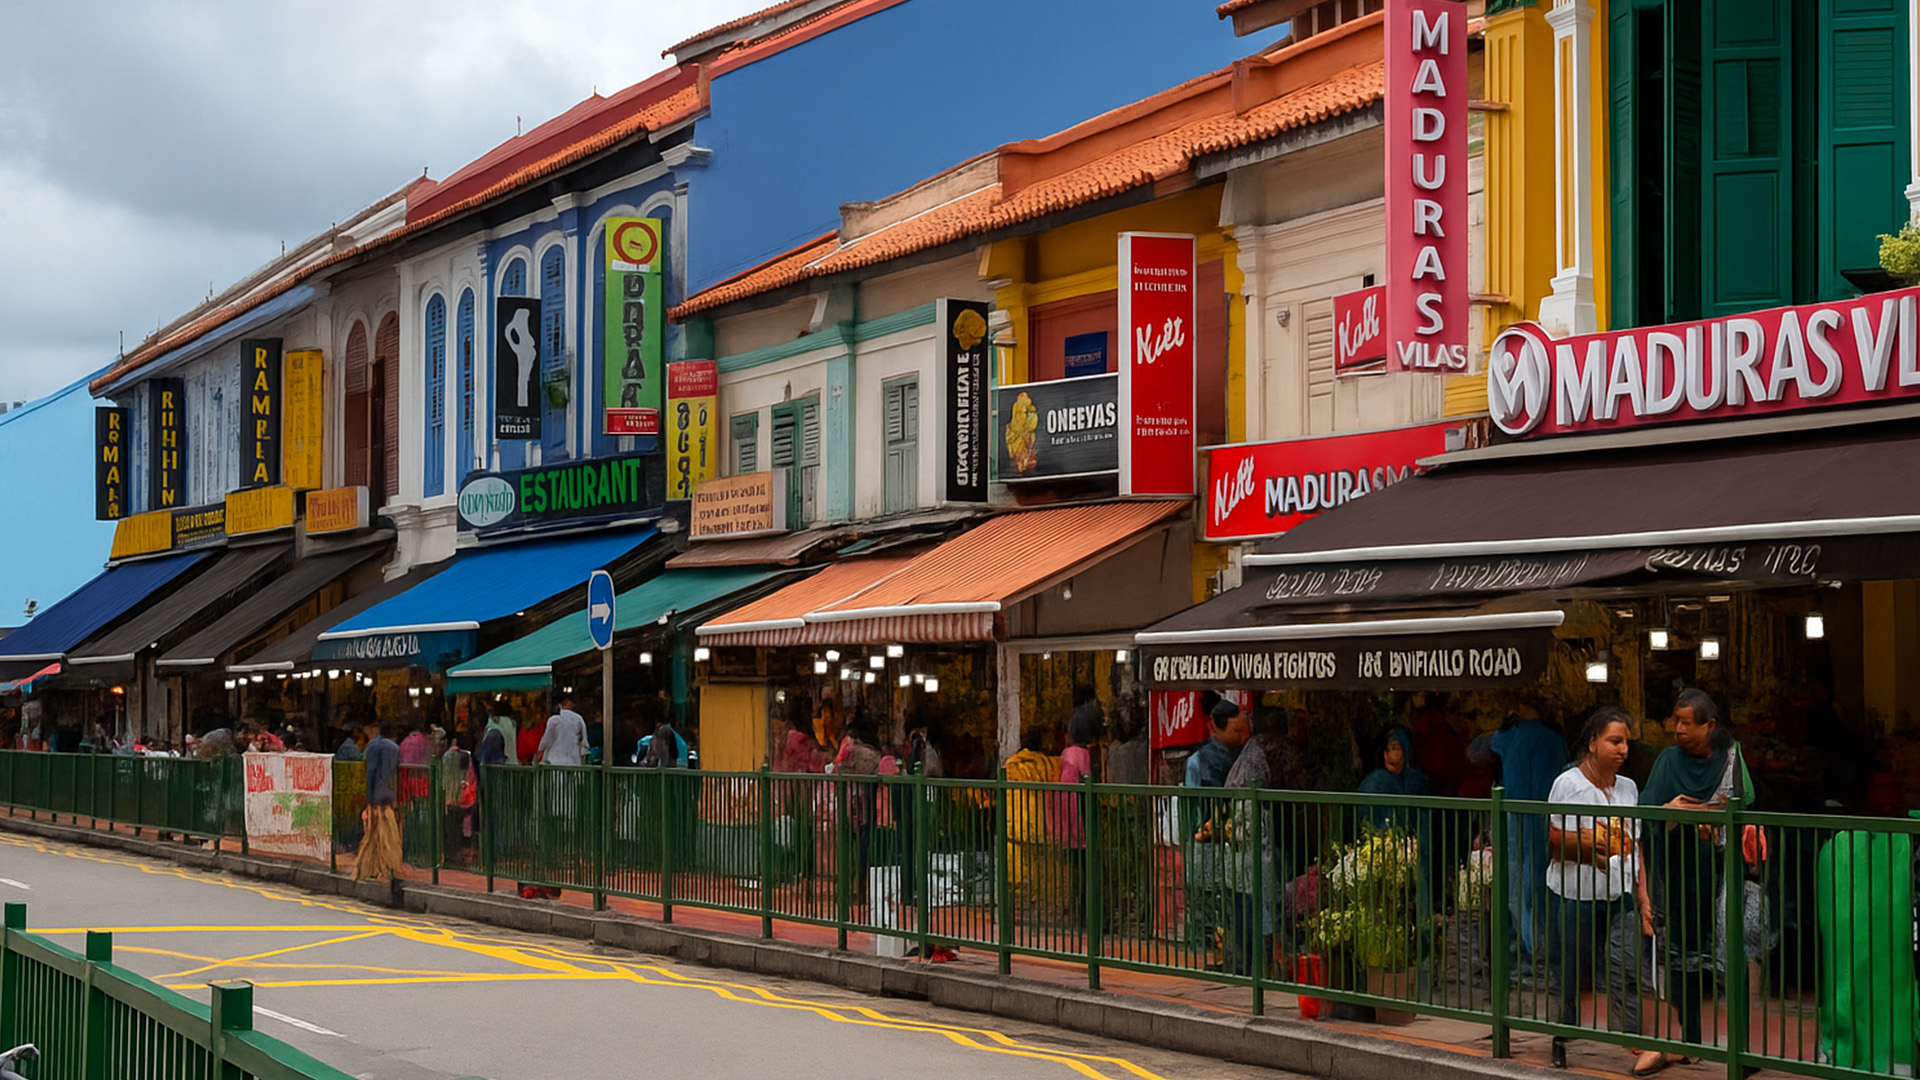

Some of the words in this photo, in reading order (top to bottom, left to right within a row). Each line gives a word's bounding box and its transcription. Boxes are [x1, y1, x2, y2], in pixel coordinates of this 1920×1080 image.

[1410, 9, 1449, 336] MADURAS
[1396, 340, 1467, 369] VILAS
[1556, 310, 1845, 427] MADURAS
[520, 458, 640, 513] ESTAURANT
[1468, 647, 1522, 677] ROAD
